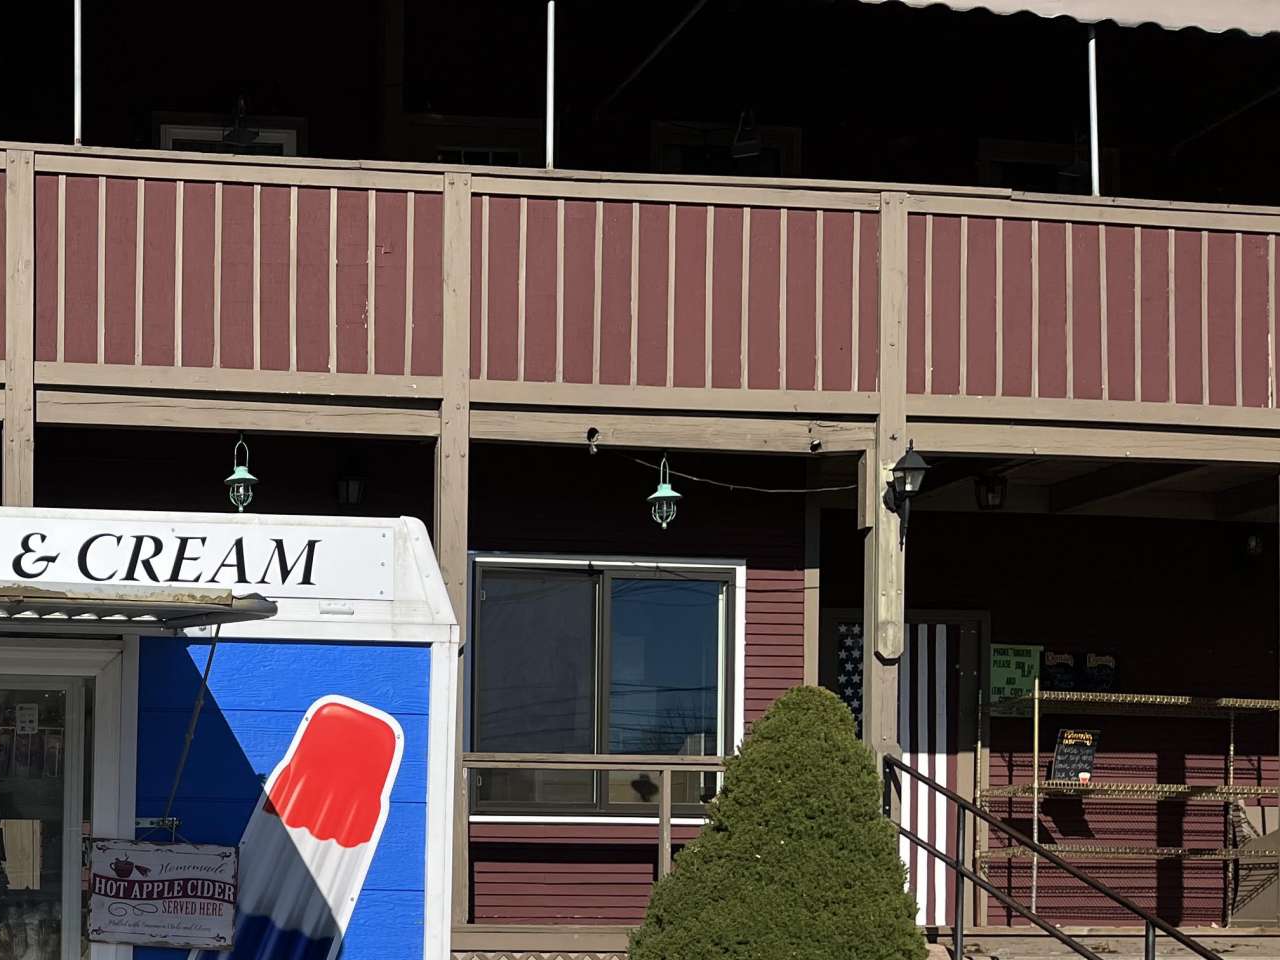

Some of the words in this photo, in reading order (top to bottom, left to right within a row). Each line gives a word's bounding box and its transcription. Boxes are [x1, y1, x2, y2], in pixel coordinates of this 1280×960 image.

[11, 532, 62, 579] &
[76, 533, 323, 586] CREAM
[95, 877, 128, 898] HOT
[130, 880, 184, 899] APPLE
[187, 878, 235, 901] CIDER
[161, 900, 197, 916] SERVED
[199, 901, 224, 917] HERE
